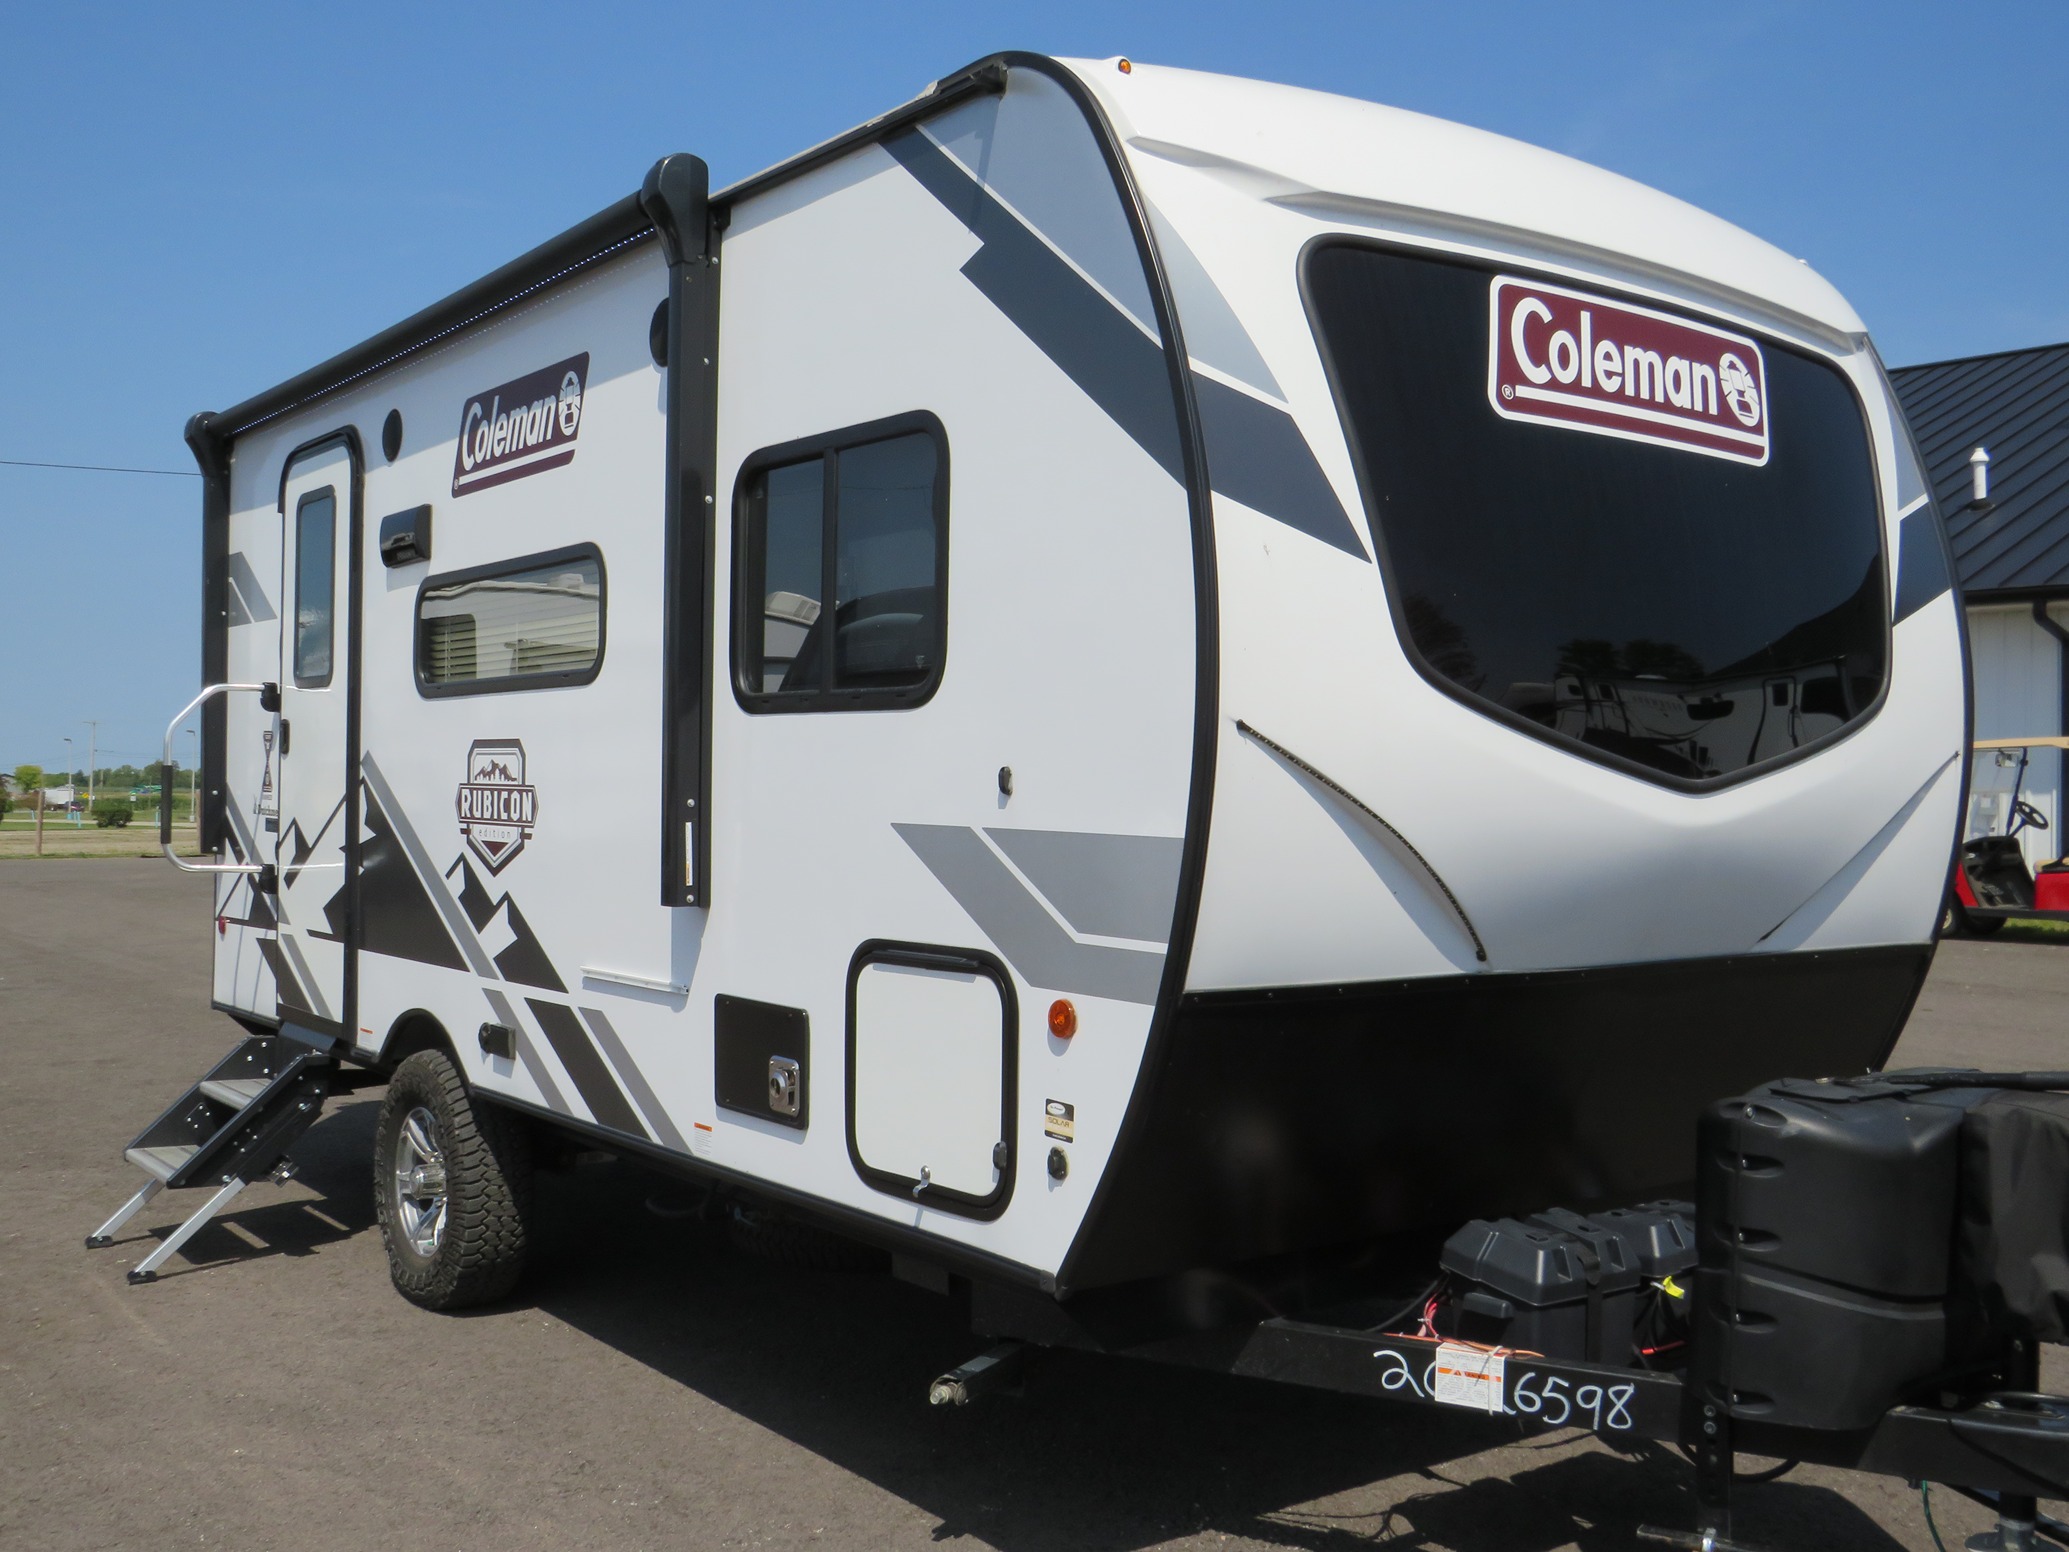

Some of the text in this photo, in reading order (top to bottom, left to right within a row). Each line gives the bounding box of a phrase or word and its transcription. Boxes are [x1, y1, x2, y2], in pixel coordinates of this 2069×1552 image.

[1510, 296, 1719, 416] Coleman
[462, 394, 557, 472] Coleman
[460, 788, 533, 822] RUBICON
[478, 828, 512, 840] edition
